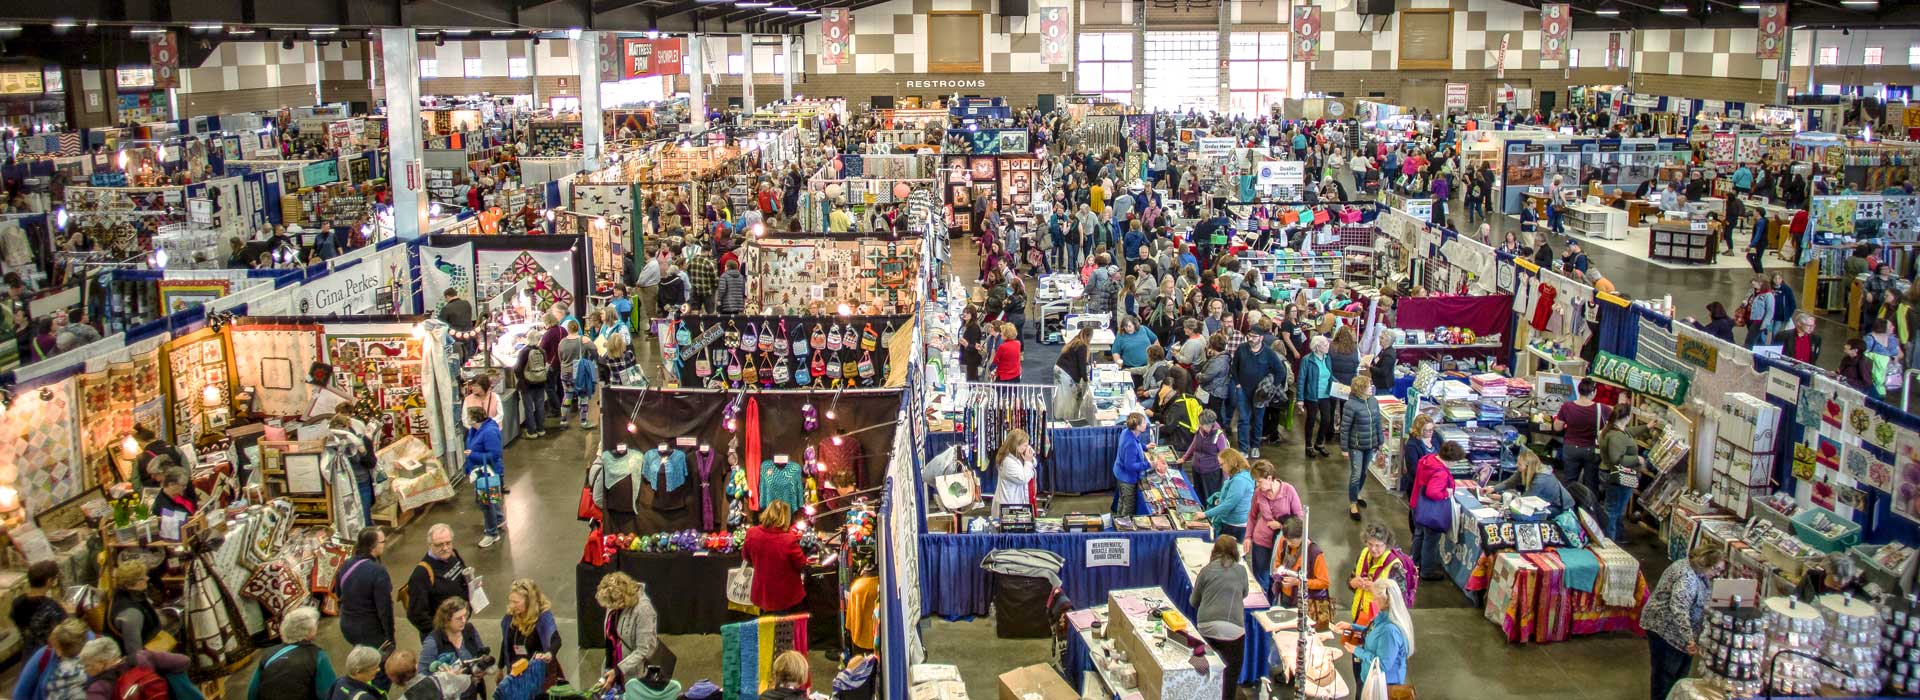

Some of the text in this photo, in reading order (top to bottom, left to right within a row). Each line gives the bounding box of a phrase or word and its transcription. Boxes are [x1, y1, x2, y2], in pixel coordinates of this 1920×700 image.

[830, 10, 841, 55] 500
[1048, 9, 1059, 54] 600
[1302, 7, 1312, 52] 700
[1548, 6, 1560, 51] 800
[1765, 5, 1777, 50] 900
[158, 33, 170, 79] 200
[634, 56, 648, 72] FIRM
[906, 79, 986, 88] RESTROOMS
[315, 289, 344, 309] Gina
[345, 274, 379, 298] Perkes
